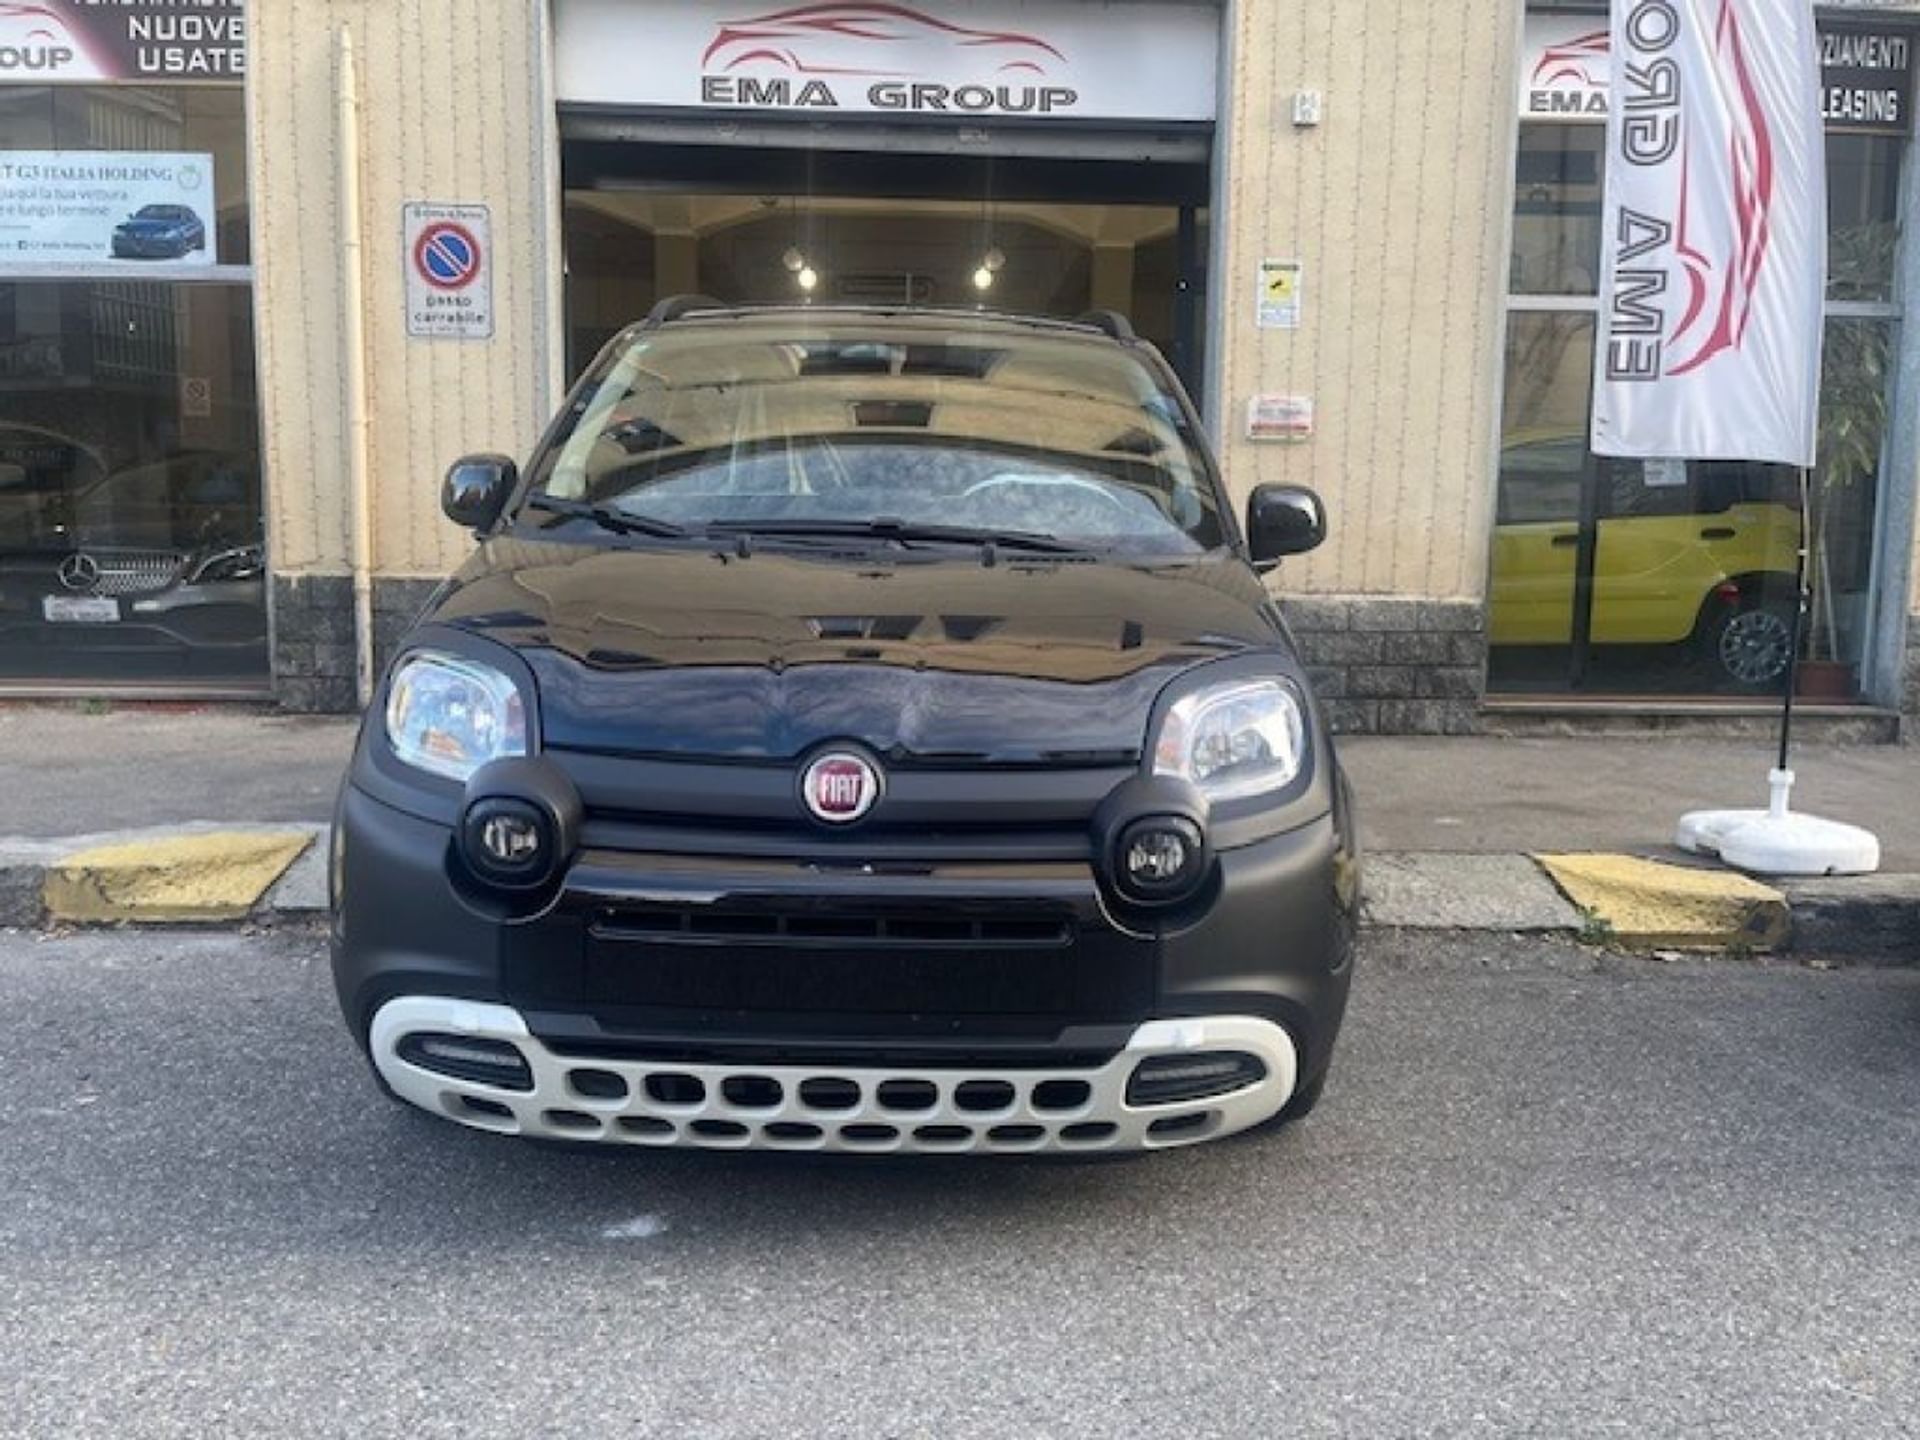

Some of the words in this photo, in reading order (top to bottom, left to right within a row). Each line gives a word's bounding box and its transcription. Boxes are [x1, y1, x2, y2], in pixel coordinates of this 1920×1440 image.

[129, 15, 244, 41] NUOVE
[138, 47, 244, 72] USATE
[701, 75, 839, 107] EMA
[867, 82, 1079, 112] GROUP
[1529, 90, 1608, 112] EMA
[1819, 87, 1897, 121] LEASING
[43, 166, 95, 180] ITALIA
[98, 167, 172, 181] HOLDING
[820, 773, 861, 803] FIAT
